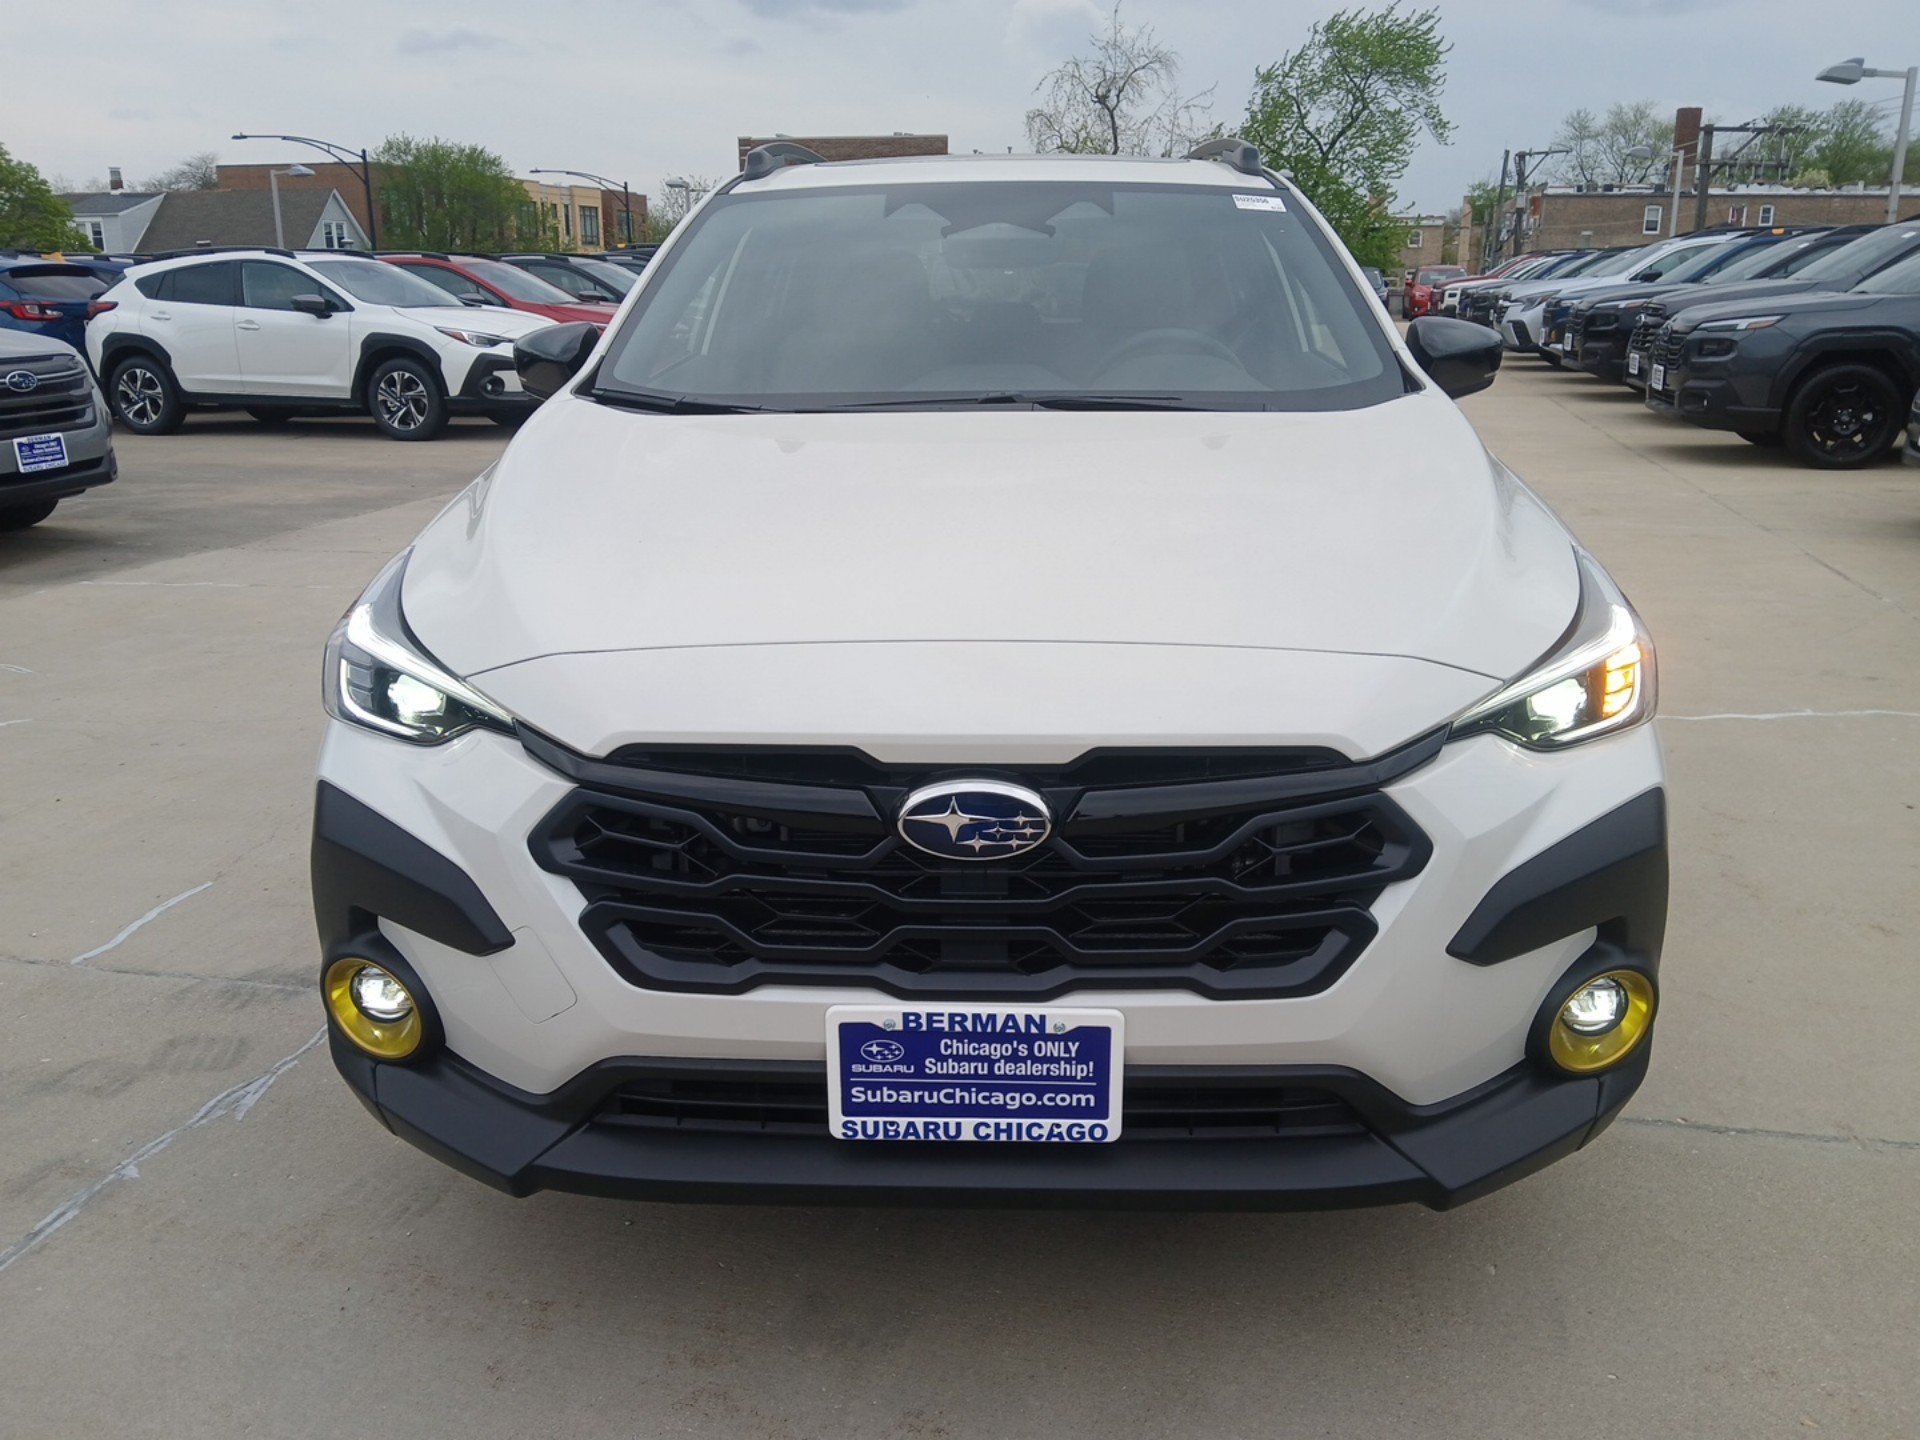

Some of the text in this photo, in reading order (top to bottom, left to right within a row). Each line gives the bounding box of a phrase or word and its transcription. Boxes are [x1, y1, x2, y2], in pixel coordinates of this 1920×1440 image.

[902, 1012, 1046, 1034] BERMAN
[940, 1039, 1080, 1058] Chicago's ONLY
[851, 1063, 914, 1073] SUBARU
[924, 1058, 1094, 1080] Subaru dealership!
[851, 1086, 1095, 1109] SubaruChicago.com
[841, 1120, 1109, 1142] SUBARU CHICAGO
